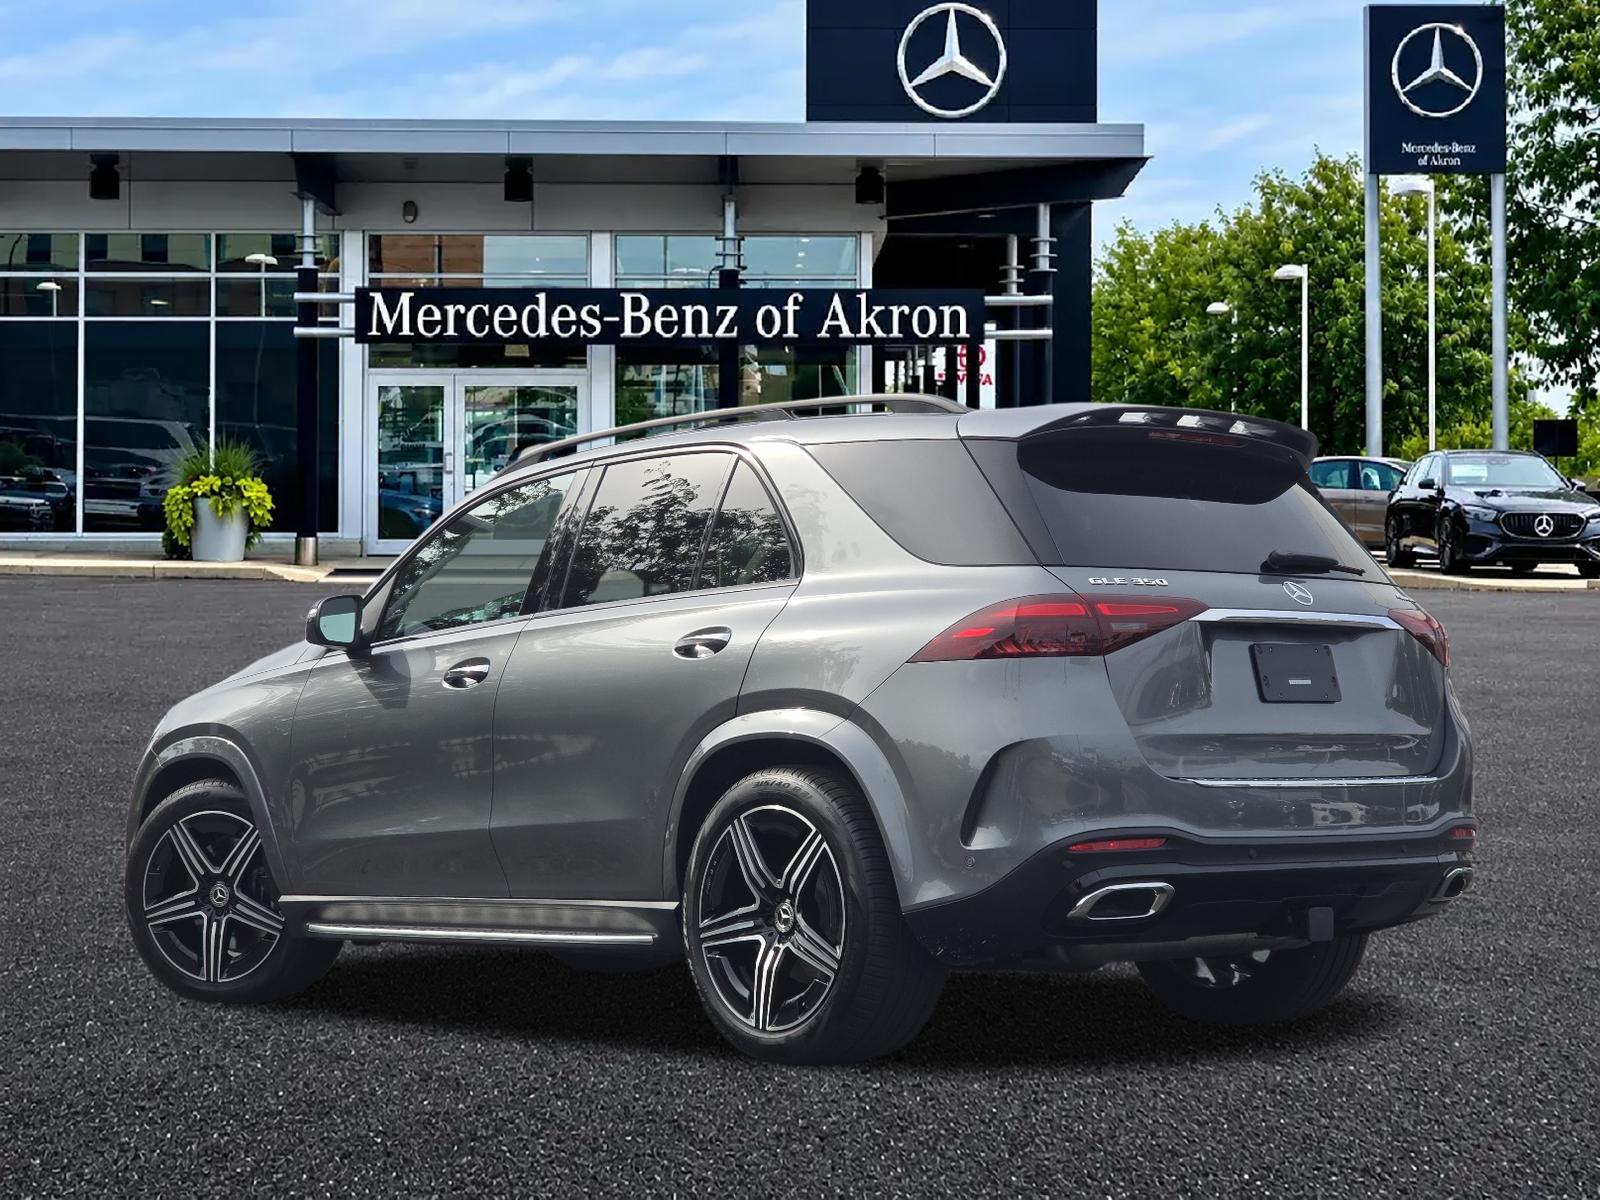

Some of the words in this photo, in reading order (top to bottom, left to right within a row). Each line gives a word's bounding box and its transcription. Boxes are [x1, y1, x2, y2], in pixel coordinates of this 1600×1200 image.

[1401, 142, 1476, 154] Mercedes-Benz
[1417, 155, 1428, 166] of
[1430, 155, 1461, 166] Akron
[367, 291, 739, 339] Mercedes-Benz
[756, 291, 803, 339] of
[816, 291, 971, 339] Akron
[1088, 577, 1129, 586] GLE
[1130, 577, 1169, 587] 350
